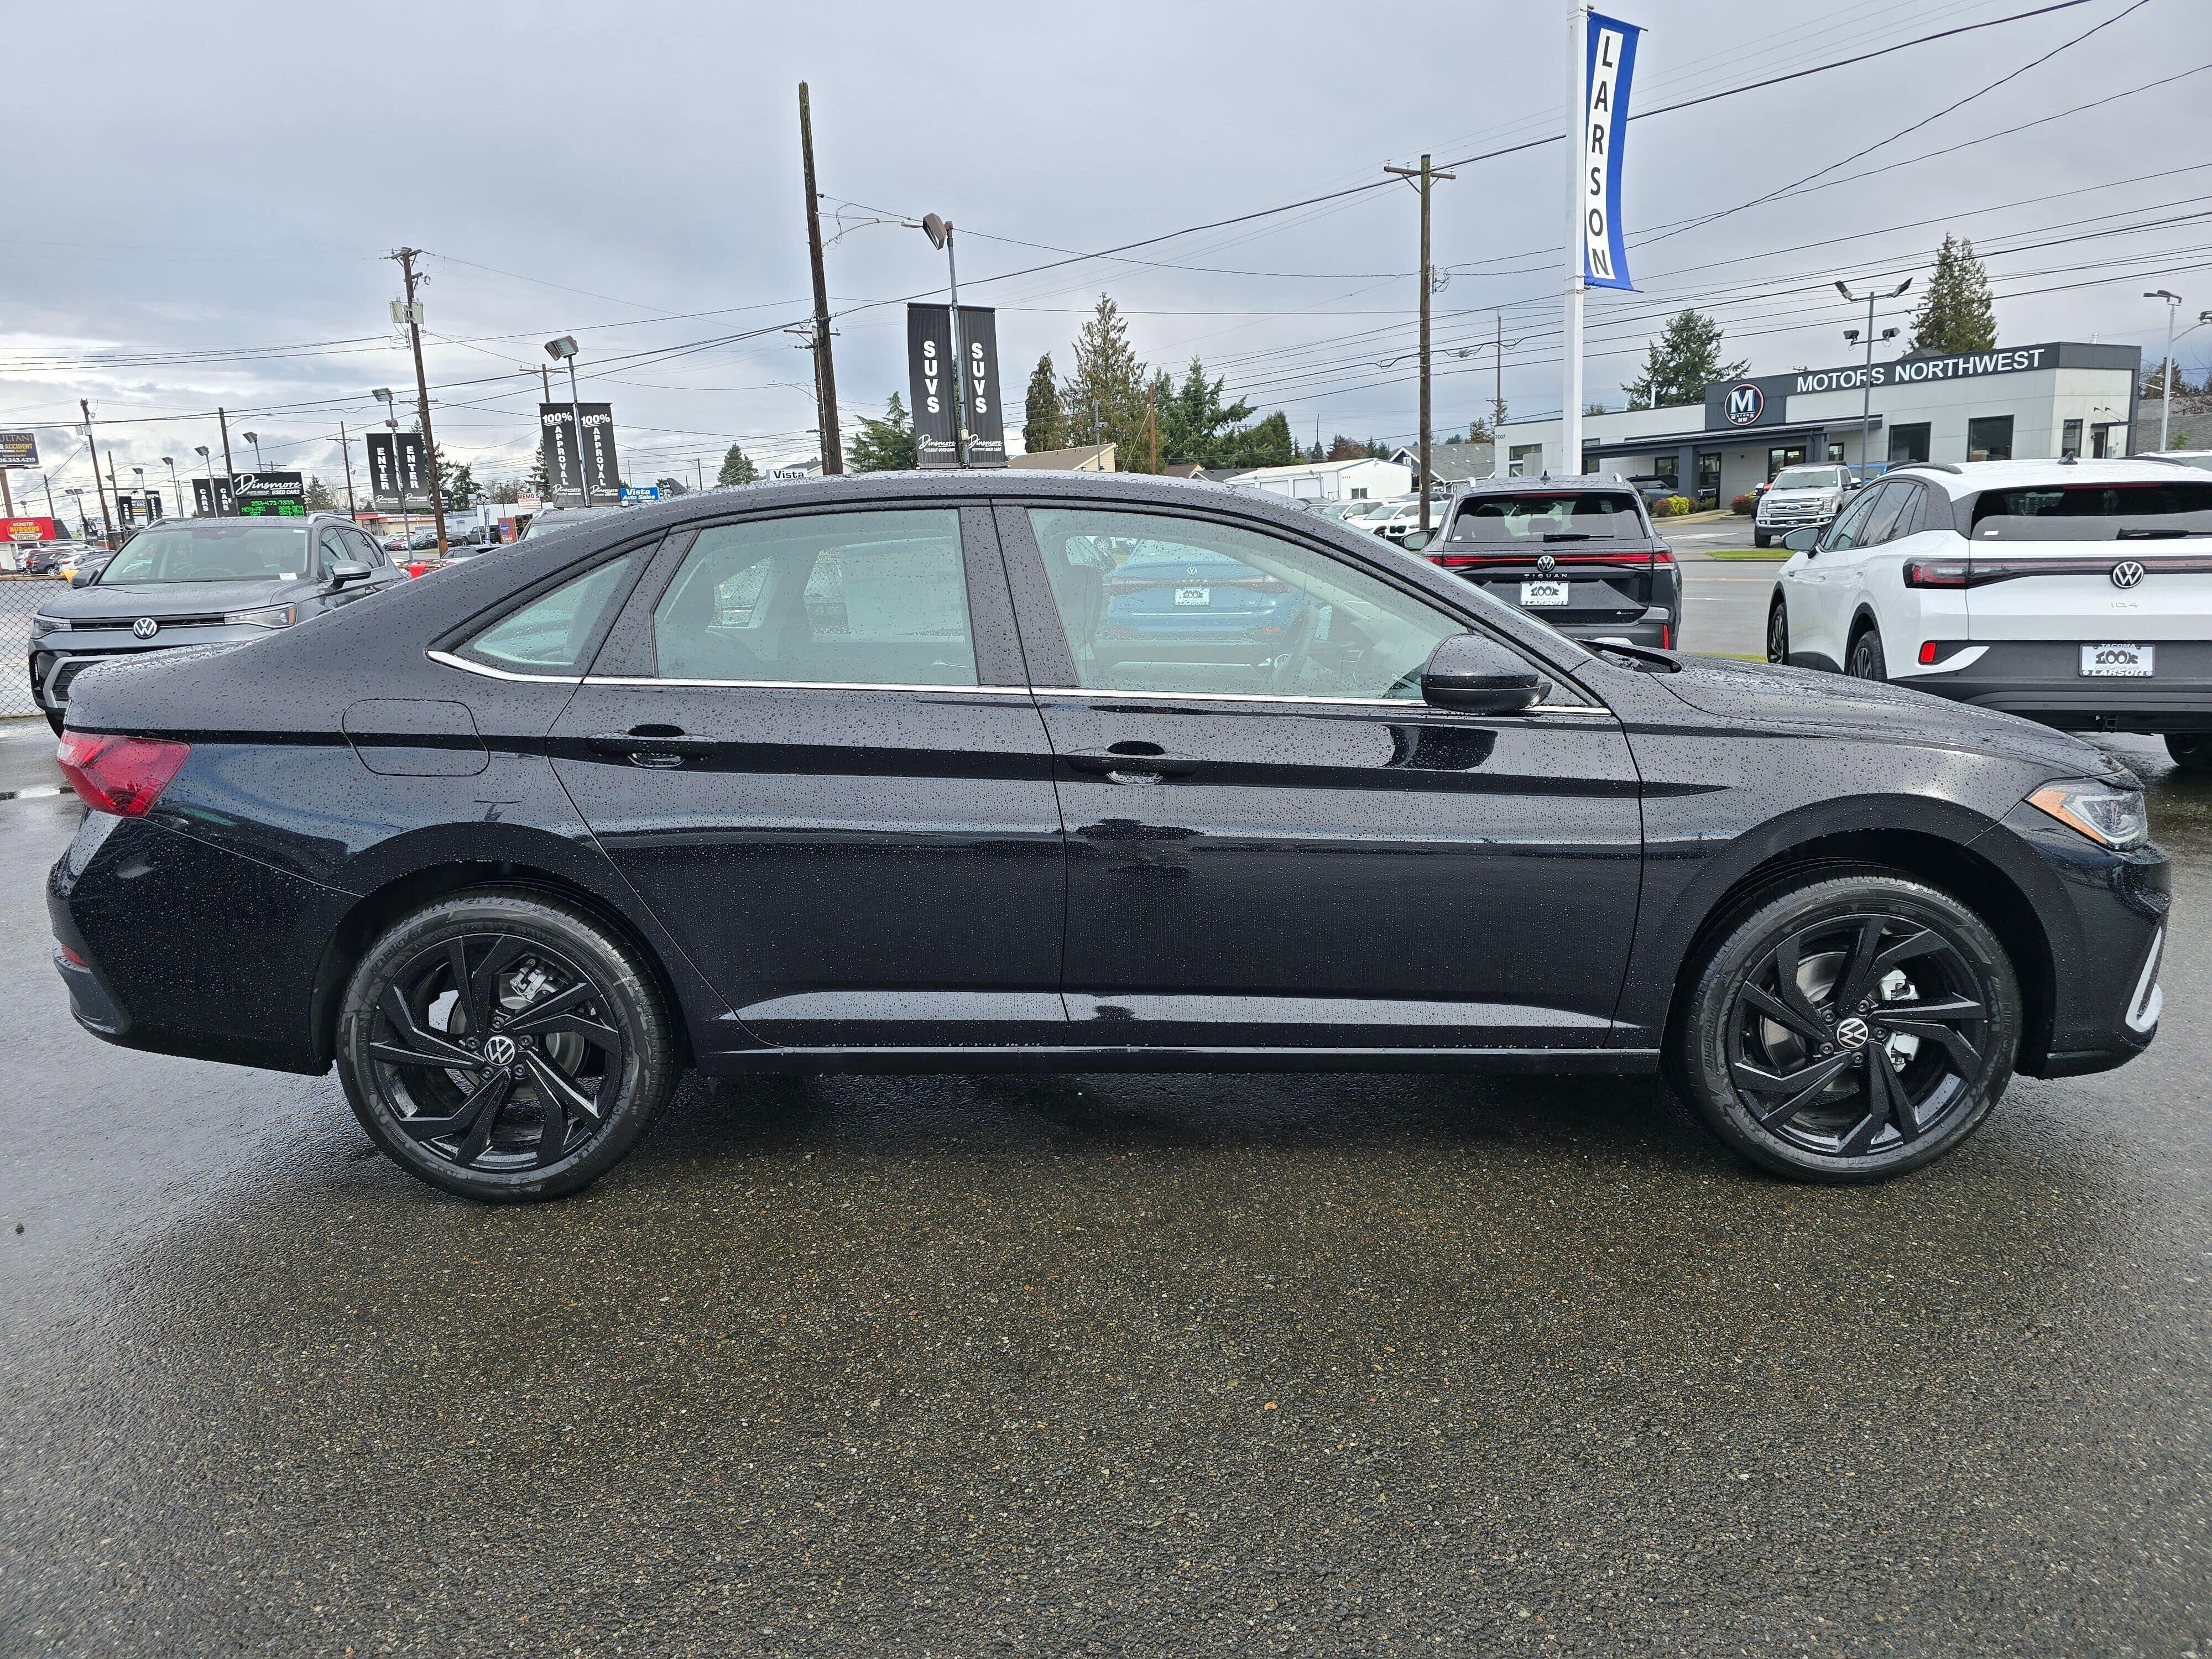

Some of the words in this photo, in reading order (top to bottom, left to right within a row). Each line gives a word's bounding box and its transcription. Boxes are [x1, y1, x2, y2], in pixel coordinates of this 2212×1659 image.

[1589, 35, 1614, 276] LARSON
[924, 340, 940, 413] SUVS
[972, 342, 987, 414] SUVS
[1797, 367, 1885, 392] MOTORS
[1895, 349, 2045, 382] NORTHWEST
[542, 412, 573, 425] 100%
[581, 414, 611, 425] 100%
[555, 426, 569, 485] APPROVAL
[593, 427, 606, 486] APPROVAL
[919, 434, 956, 450] Dinsmore
[968, 434, 1003, 449] Dinsmore
[377, 447, 389, 490] ENTER
[406, 446, 419, 488] ENTER
[773, 470, 804, 479] Vista
[199, 488, 209, 512] CARS
[220, 488, 229, 511] CARS
[234, 474, 302, 495] Dinsmore
